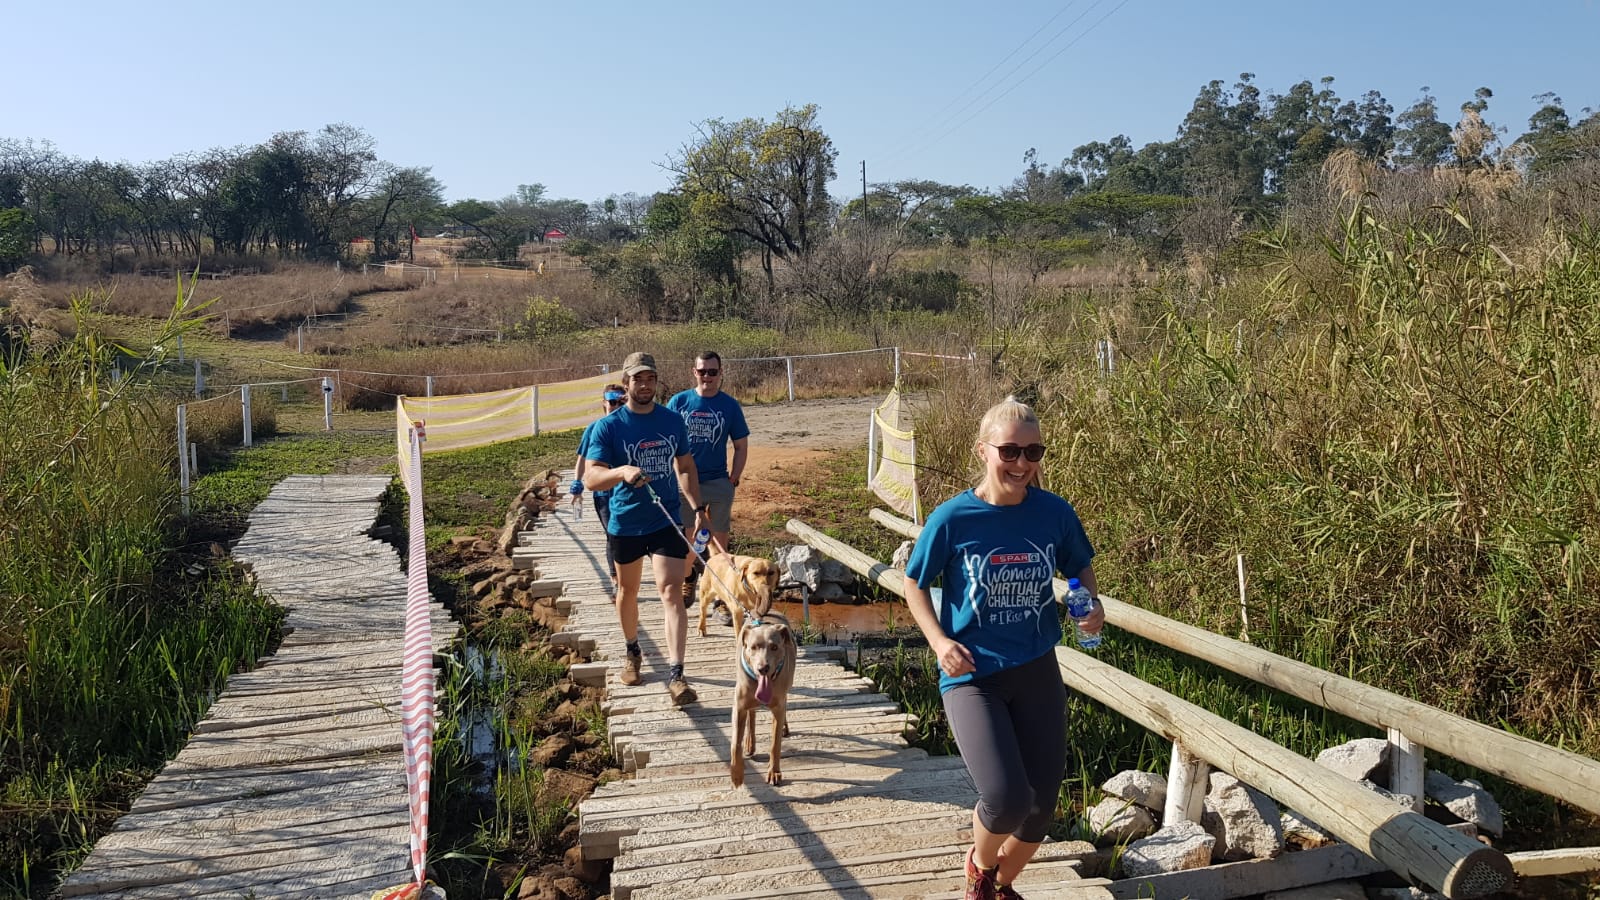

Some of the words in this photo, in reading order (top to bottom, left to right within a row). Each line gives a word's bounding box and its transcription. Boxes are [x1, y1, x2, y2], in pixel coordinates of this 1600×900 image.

[640, 456, 668, 466] VIRTUAL
[999, 555, 1028, 563] SPAR
[987, 562, 1047, 586] Women's
[991, 581, 1041, 595] VIRTUAL
[988, 595, 1040, 608] CHALLENGE
